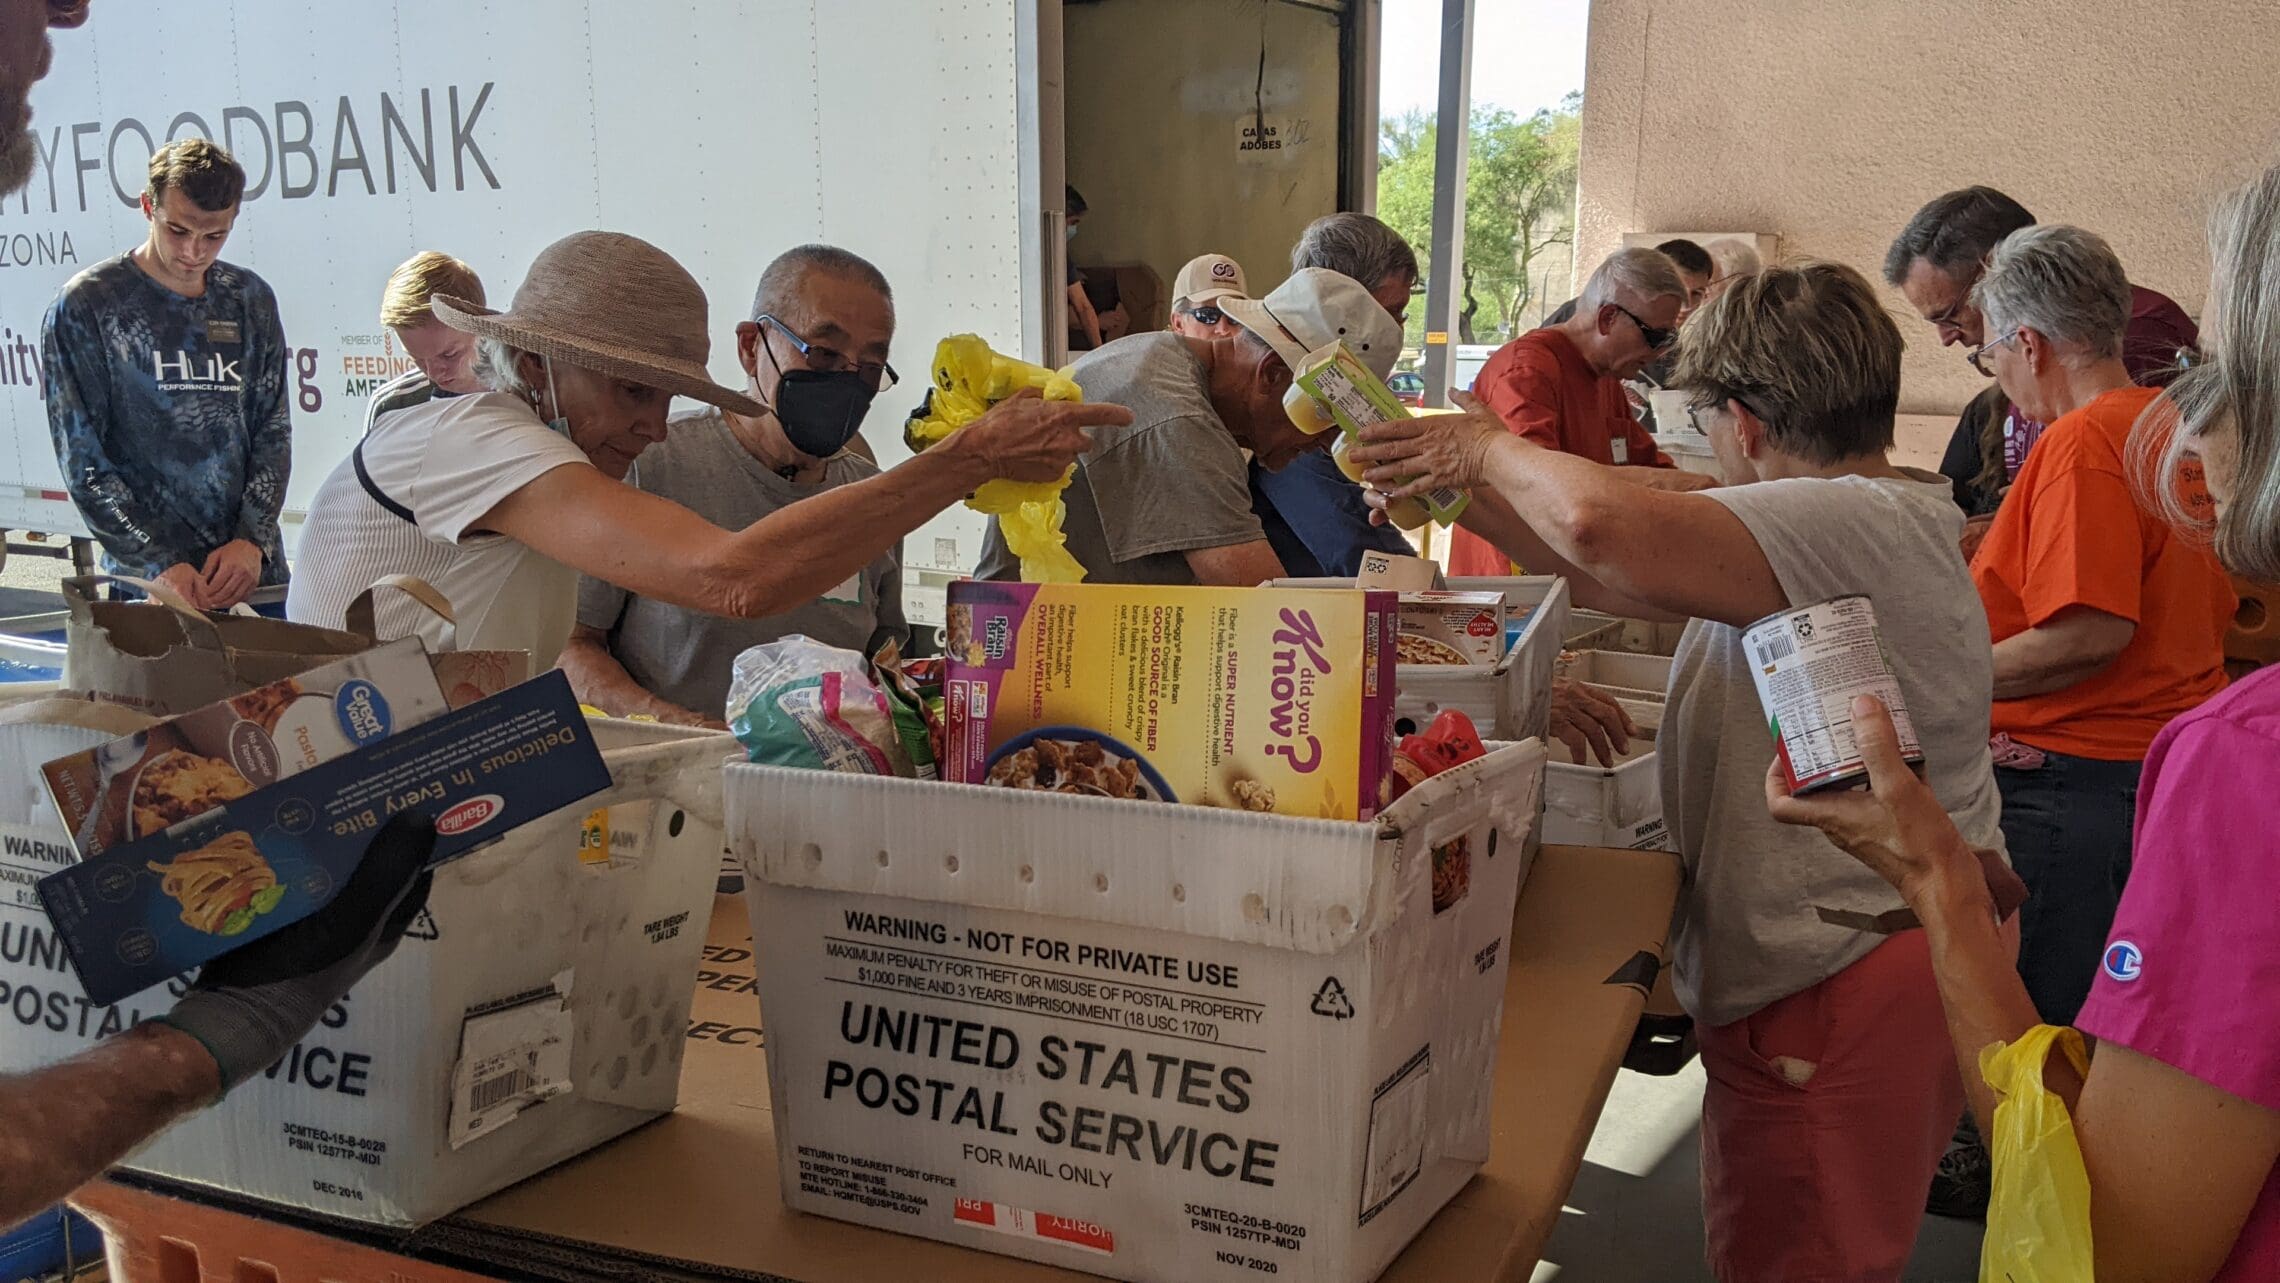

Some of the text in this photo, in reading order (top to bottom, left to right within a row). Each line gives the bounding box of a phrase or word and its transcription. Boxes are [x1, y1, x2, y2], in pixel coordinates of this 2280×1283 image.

[1240, 140, 1282, 150] ADOBES
[1242, 127, 1277, 137] CAAS
[341, 336, 383, 345] MEMBER OF
[1141, 605, 1149, 625] with
[1228, 607, 1237, 631] Fiber
[985, 621, 997, 653] Bran
[993, 616, 1006, 658] Raisin
[1044, 604, 1055, 691] an important part of
[1054, 604, 1066, 675] digestive health,
[1065, 628, 1074, 652] helps
[1118, 622, 1127, 656] clusters
[1130, 627, 1138, 653] flakes
[1228, 632, 1236, 640] is
[1033, 604, 1046, 719] OVERALL WELLNESS
[1064, 654, 1072, 688] support
[1139, 635, 1148, 674] delicious
[1160, 646, 1170, 681] Original
[1172, 655, 1181, 681] Raisin
[1226, 650, 1237, 689] SUPER
[1147, 606, 1161, 751] GOOD SOURCE OF FIBER
[1171, 683, 1179, 704] Bran
[1211, 607, 1226, 766] that helps support digestive health
[1263, 606, 1333, 774] Know?
[351, 685, 384, 736] Great
[1124, 693, 1134, 729] crunchy
[1137, 704, 1144, 714] of
[1295, 667, 1314, 735] did you
[248, 731, 258, 744] No
[345, 701, 368, 740] Value
[1134, 715, 1143, 742] crispy
[1223, 693, 1235, 755] NUTRIENT
[241, 744, 257, 772] Flavors
[296, 725, 318, 766] Pasta
[478, 724, 576, 779] Delicious
[450, 767, 475, 790] In
[380, 775, 446, 819] Every
[326, 807, 378, 842] Bite.
[439, 800, 490, 832] Barilla
[644, 911, 690, 935] TARE WEIGHT
[665, 926, 680, 941] LBS
[844, 910, 947, 944] WARNING
[967, 928, 1015, 954] NOT
[1022, 936, 1070, 963] FOR
[1078, 944, 1179, 980] PRIVATE
[1187, 960, 1239, 989] USE
[826, 943, 1263, 1024] MAXIMUM PENALTY FOR THEFT OR MISUSE OF POSTAL PROPERTY
[858, 966, 1219, 1042] $1,000 FINE AND 3 YEARS IMPRISONMENT (18 USC 1707)
[840, 1000, 1253, 1115] UNITED STATES
[823, 1059, 1280, 1188] POSTAL SERVICE
[288, 1136, 381, 1166] PSIN 1257TP-MDI
[798, 1145, 958, 1188] RETURN TO NEAREST POST OFFICE
[962, 1143, 1114, 1190] FOR MAIL ONLY
[313, 1179, 336, 1195] DEC
[799, 1159, 887, 1186] TO REPORT MISUSE
[800, 1171, 819, 1183] MTE
[801, 1182, 832, 1197] EMAIL:
[1184, 1203, 1306, 1238] 3CMTEQ-20-B-0020
[1191, 1218, 1300, 1251] PSIN 1257TP-MDI
[1216, 1250, 1278, 1274] NOV 2020
